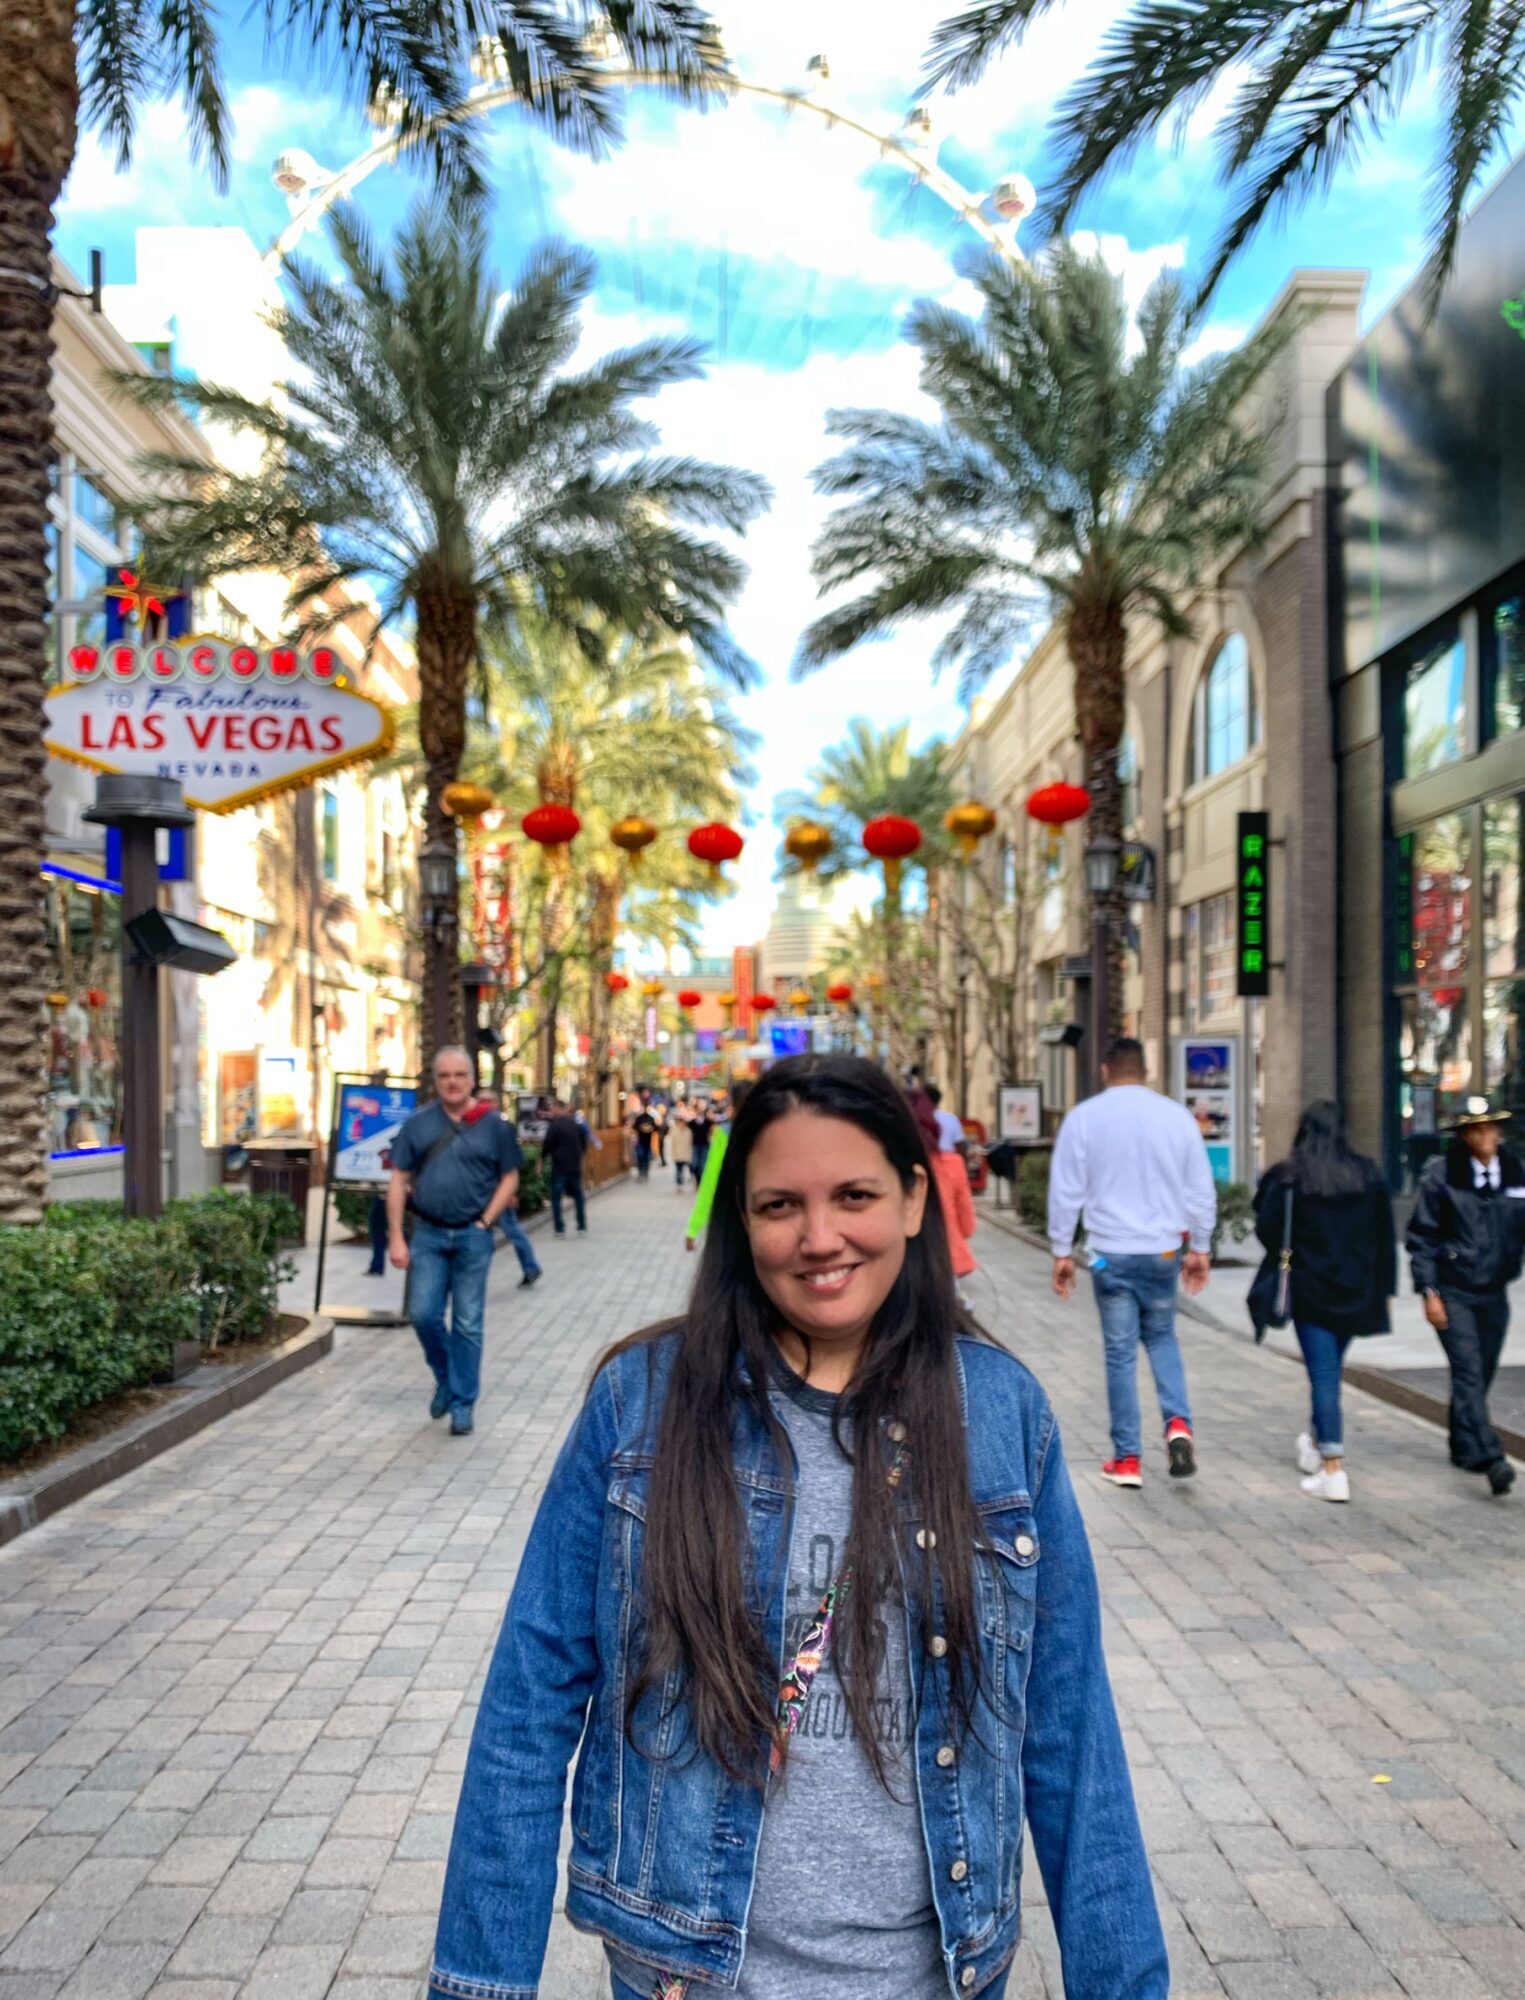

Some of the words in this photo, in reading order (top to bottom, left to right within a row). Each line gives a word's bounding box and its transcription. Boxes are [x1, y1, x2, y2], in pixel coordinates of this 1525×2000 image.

[69, 645, 334, 677] WELCOME
[104, 689, 135, 708] TO
[80, 713, 165, 750] LAS
[185, 712, 346, 753] VEGAS
[157, 760, 262, 779] NEVADA
[1242, 833, 1264, 973] RAZER
